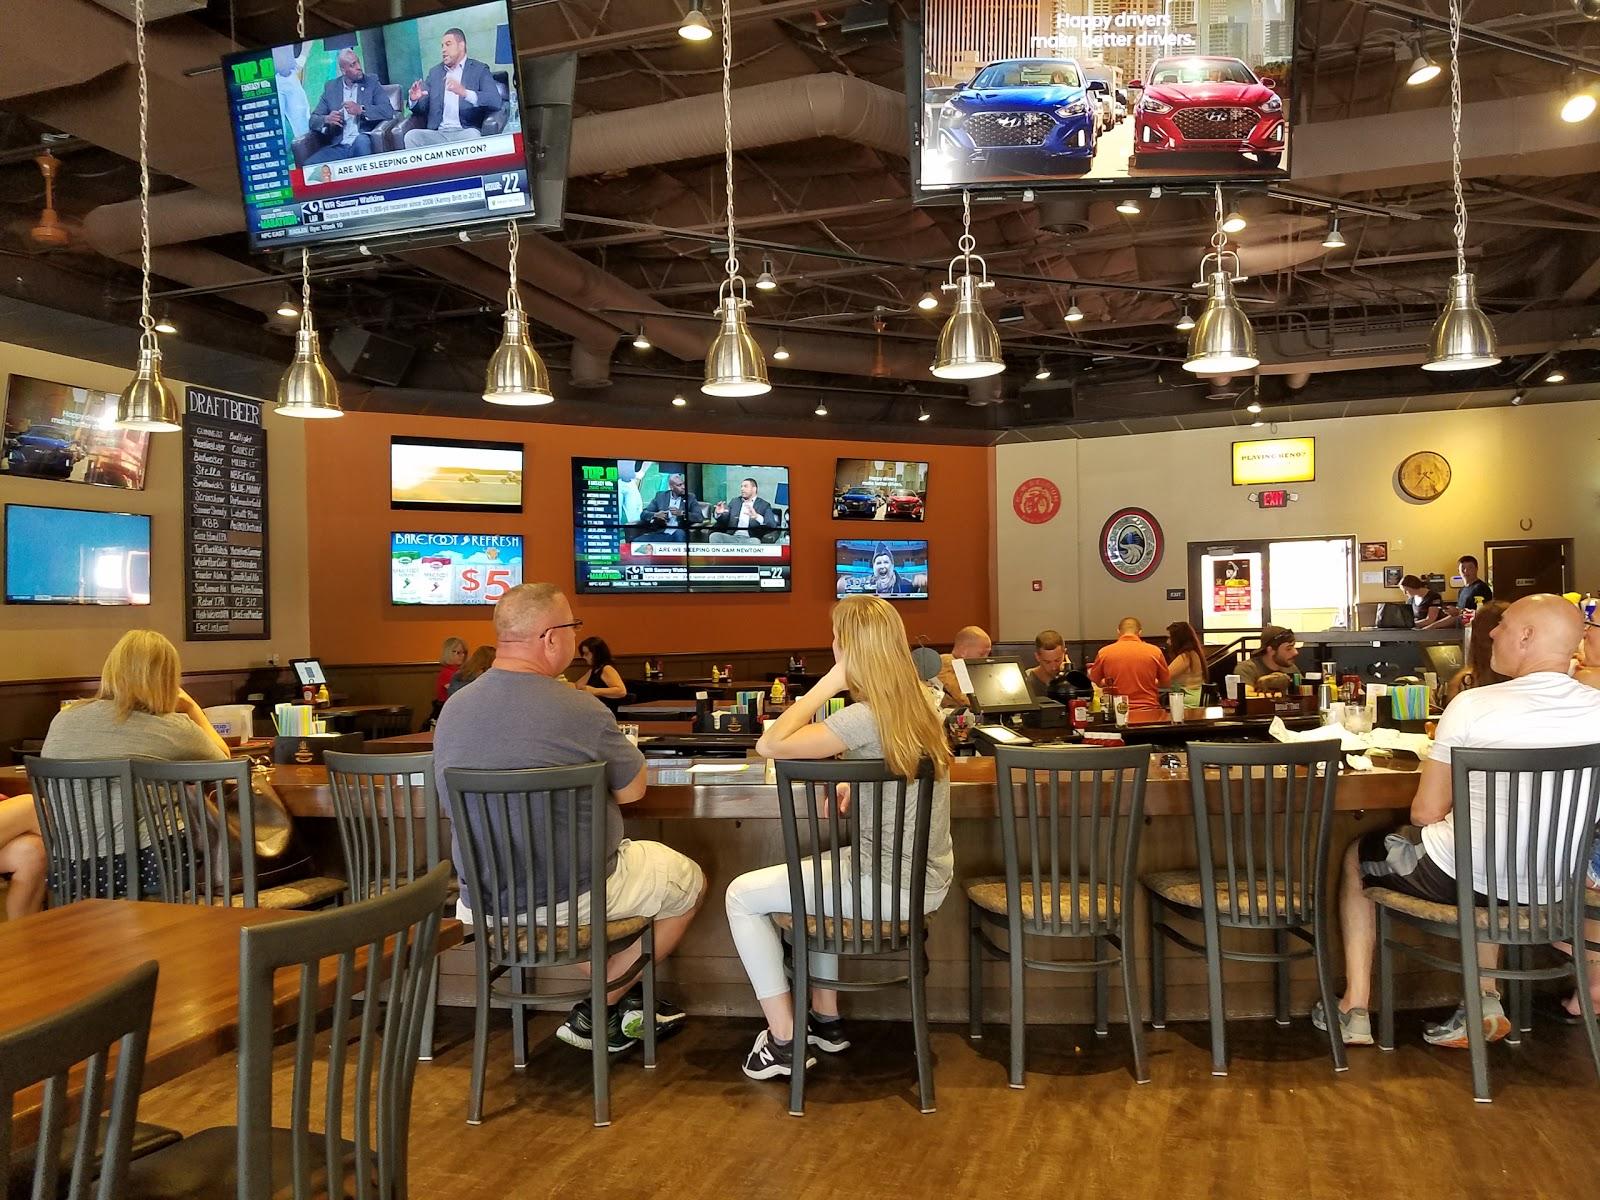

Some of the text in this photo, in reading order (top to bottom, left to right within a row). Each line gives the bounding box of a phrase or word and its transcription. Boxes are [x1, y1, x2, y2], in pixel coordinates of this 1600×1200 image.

[1056, 10, 1172, 32] Happy drivers
[1030, 30, 1196, 48] make better drivers.
[232, 57, 275, 83] TOP 10
[338, 144, 488, 175] ARE WE SLEEPING ON CAM NEWTON?
[502, 172, 520, 194] 22
[324, 194, 385, 210] WR Sammy Watkins
[196, 464, 222, 477] Stella
[230, 483, 246, 493] BLUE
[1263, 491, 1284, 506] EXIT
[472, 535, 519, 547] REFRESH
[771, 567, 783, 578] 22
[461, 568, 511, 602] $5
[246, 598, 257, 606] 312
[759, 1046, 774, 1066] N
